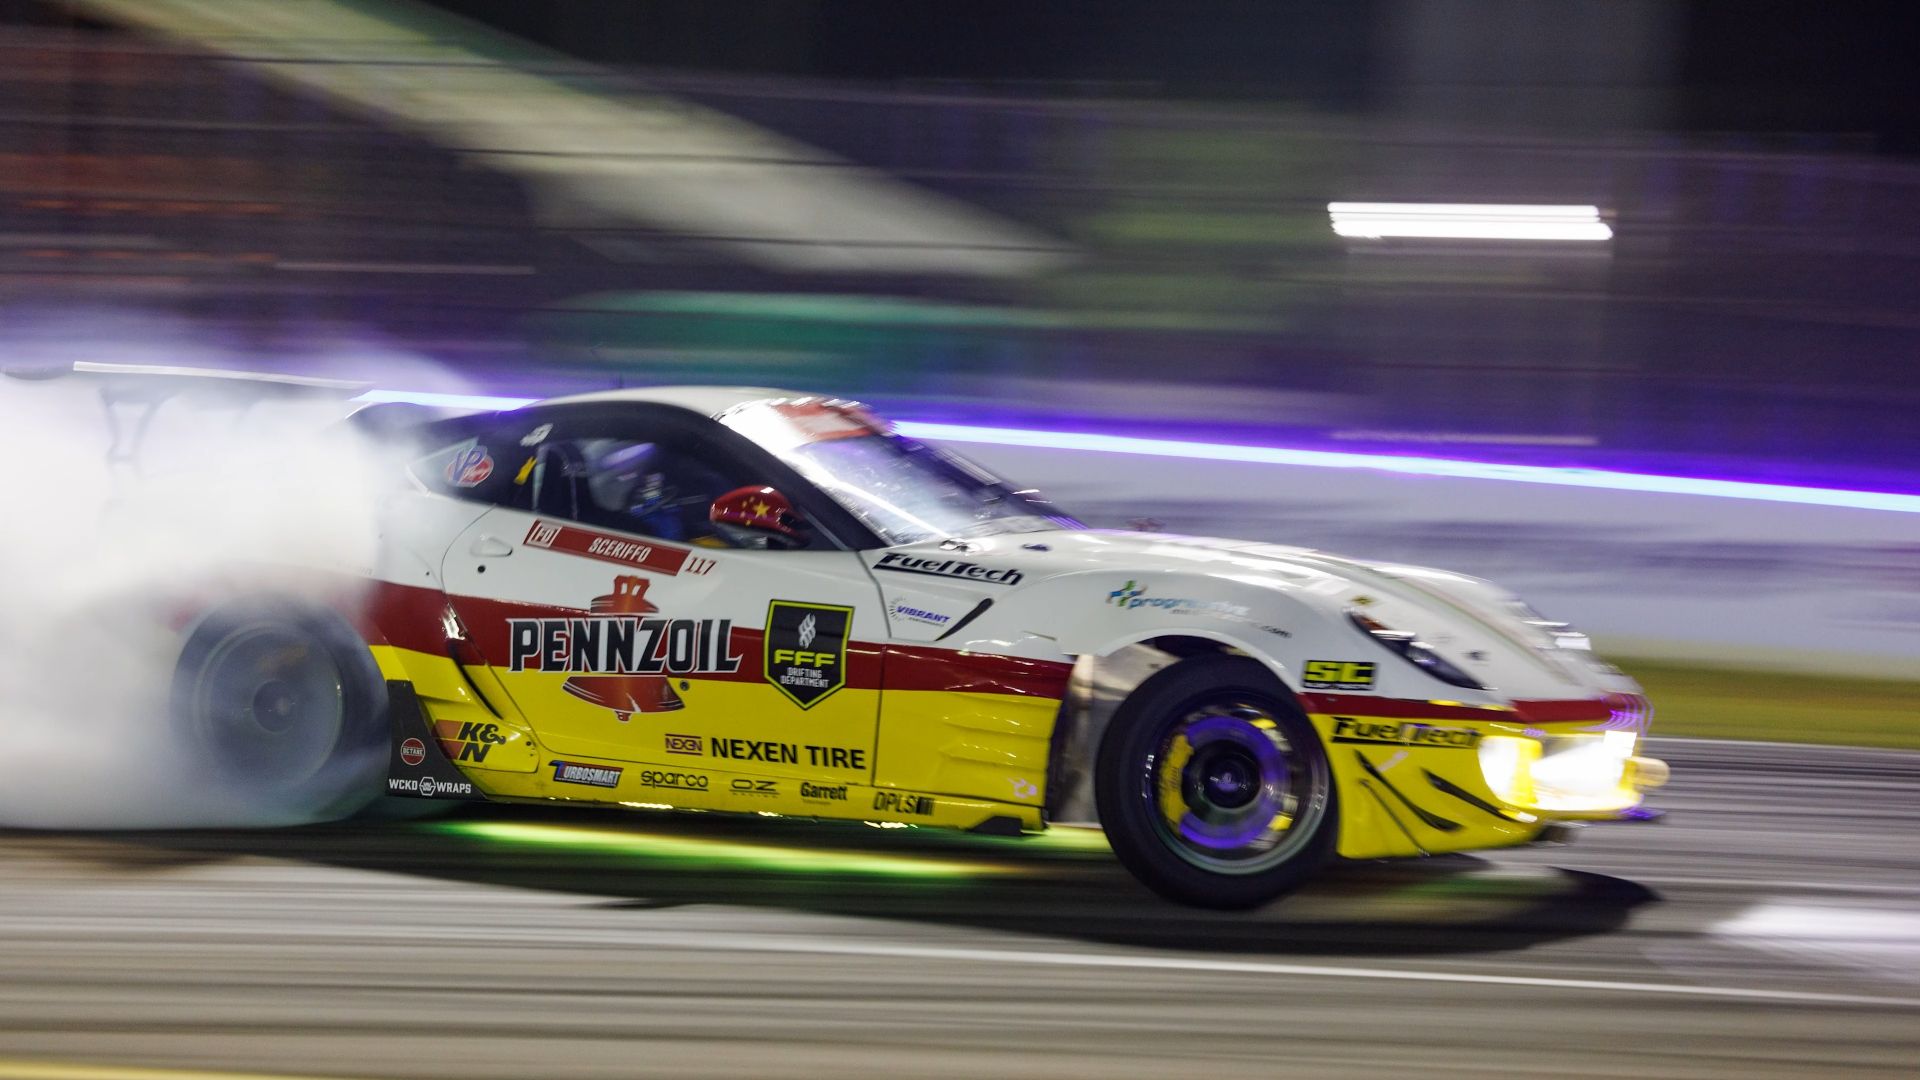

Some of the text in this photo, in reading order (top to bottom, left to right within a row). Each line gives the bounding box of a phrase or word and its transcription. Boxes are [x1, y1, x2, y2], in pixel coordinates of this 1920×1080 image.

[587, 537, 652, 563] SCERIFFO
[685, 557, 716, 576] 117
[873, 551, 1024, 586] FuelTech
[896, 605, 950, 624] VIBRANT
[506, 618, 743, 673] PENNZOIL
[774, 649, 836, 668] FFF
[780, 675, 829, 689] DEPARTMENT
[787, 666, 823, 679] DRIFTING
[665, 738, 702, 752] NEXEN
[711, 737, 866, 770] NEXEN TIRE
[388, 778, 471, 794] WCKD WRAPS
[641, 770, 709, 789] sparco
[731, 778, 780, 792] OZ
[800, 782, 849, 801] Garrett
